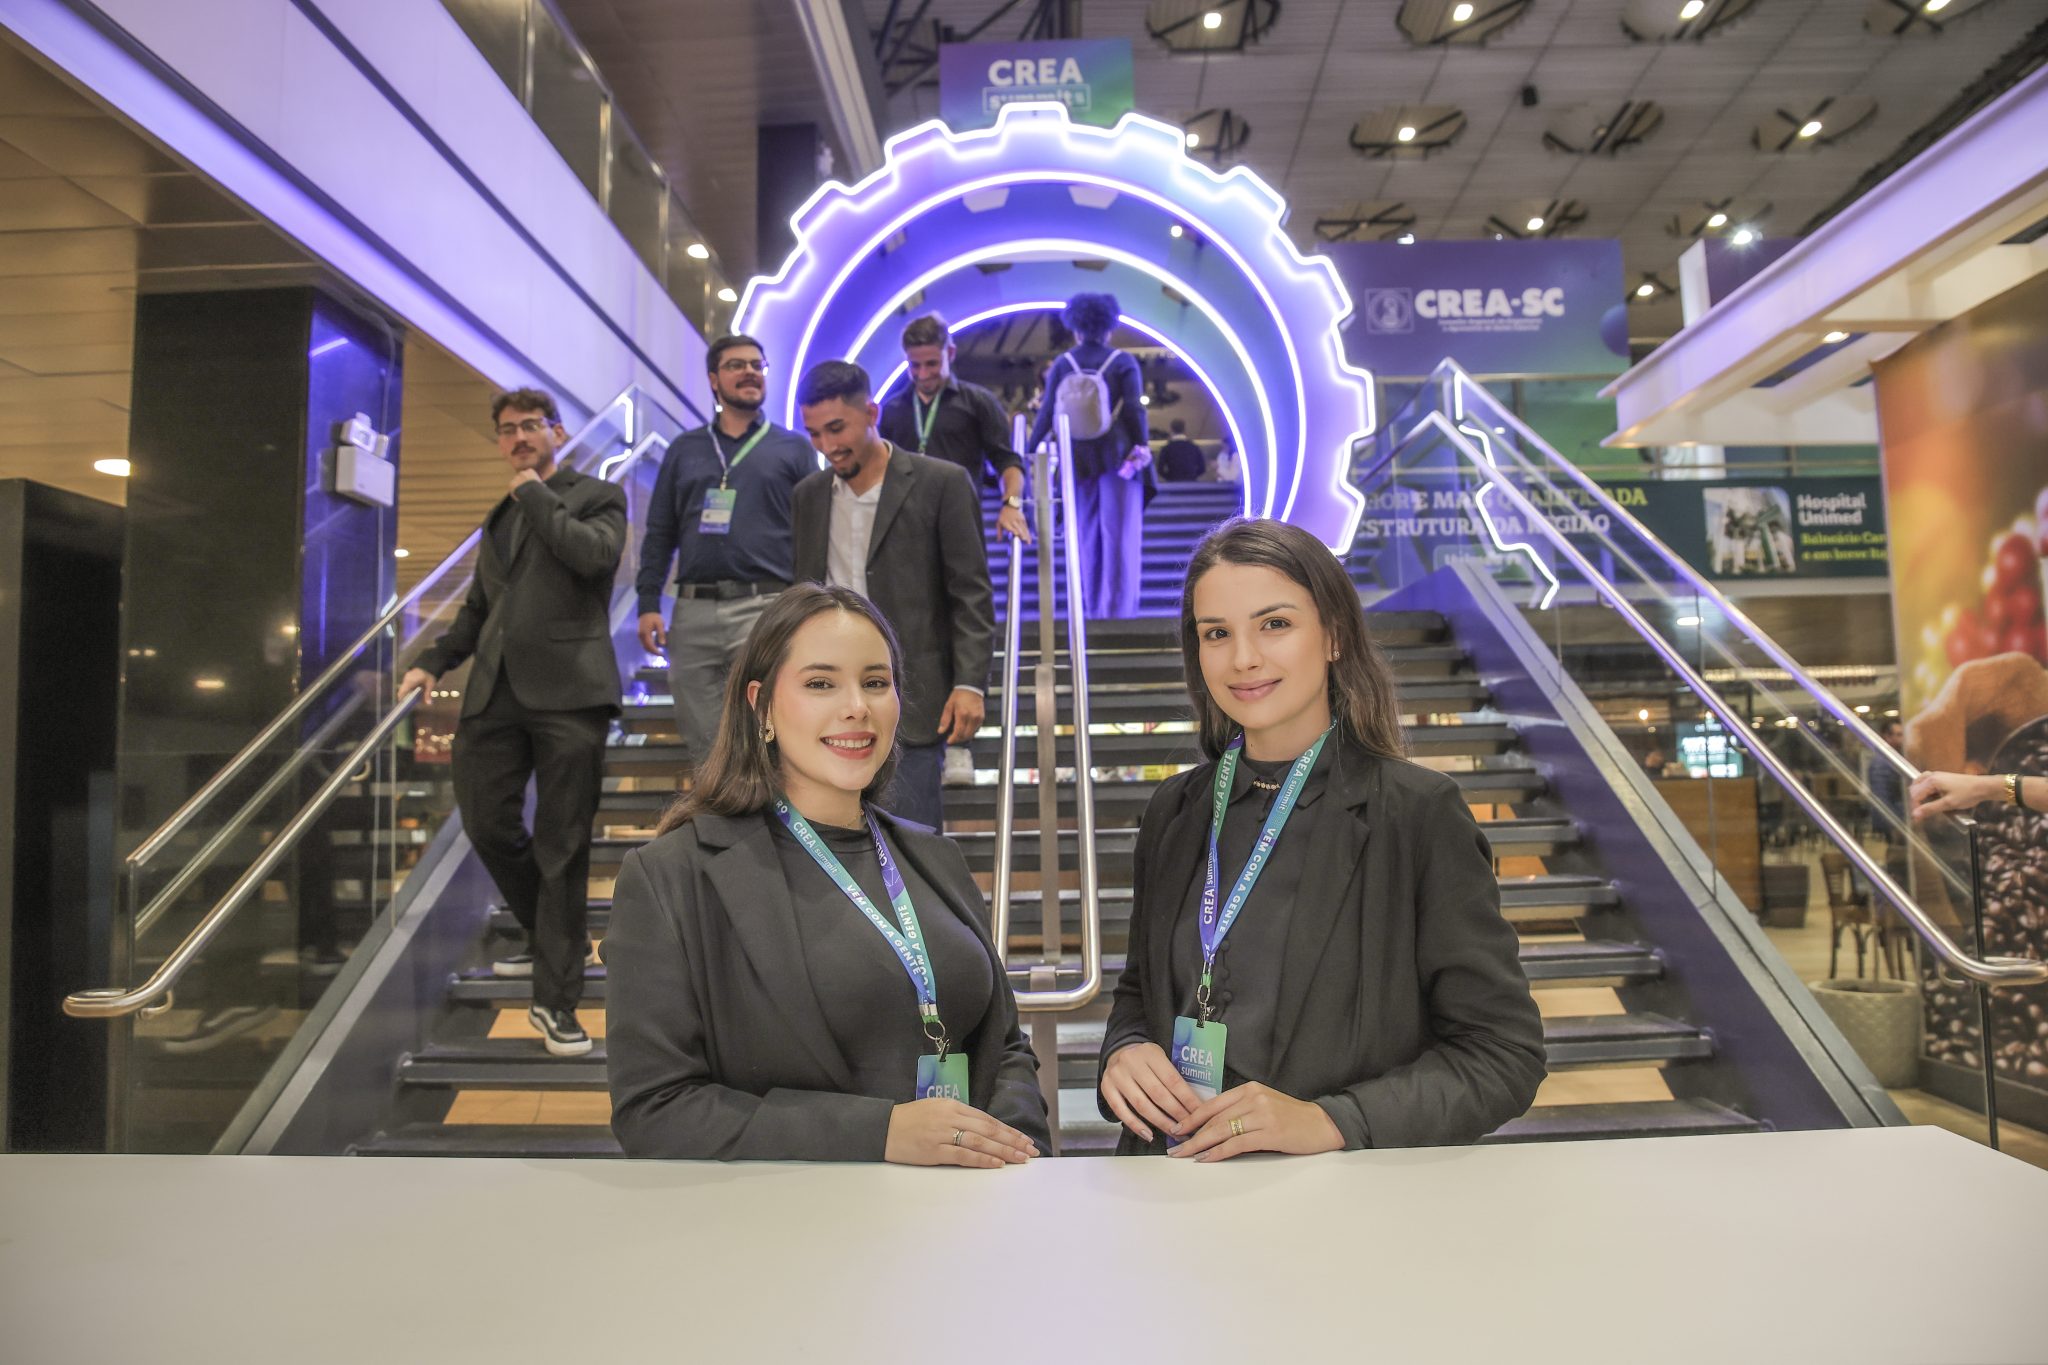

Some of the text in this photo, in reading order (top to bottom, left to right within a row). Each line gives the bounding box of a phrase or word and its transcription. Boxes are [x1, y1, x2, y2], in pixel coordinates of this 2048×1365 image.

[988, 57, 1083, 86] CREA
[1797, 492, 1867, 513] Hospital
[1798, 510, 1863, 526] Unimed
[1219, 753, 1233, 788] GENTE
[1216, 791, 1225, 799] A
[1219, 748, 1314, 933] CREA summit VEM COM A GENTE
[793, 821, 921, 975] CREA summit VEM COM A GENTE
[1203, 888, 1215, 925] CREA
[897, 904, 917, 939] GENTE
[911, 942, 921, 951] A
[1181, 1045, 1214, 1067] CREA
[1181, 1066, 1212, 1081] summit
[926, 1083, 960, 1099] CREA
